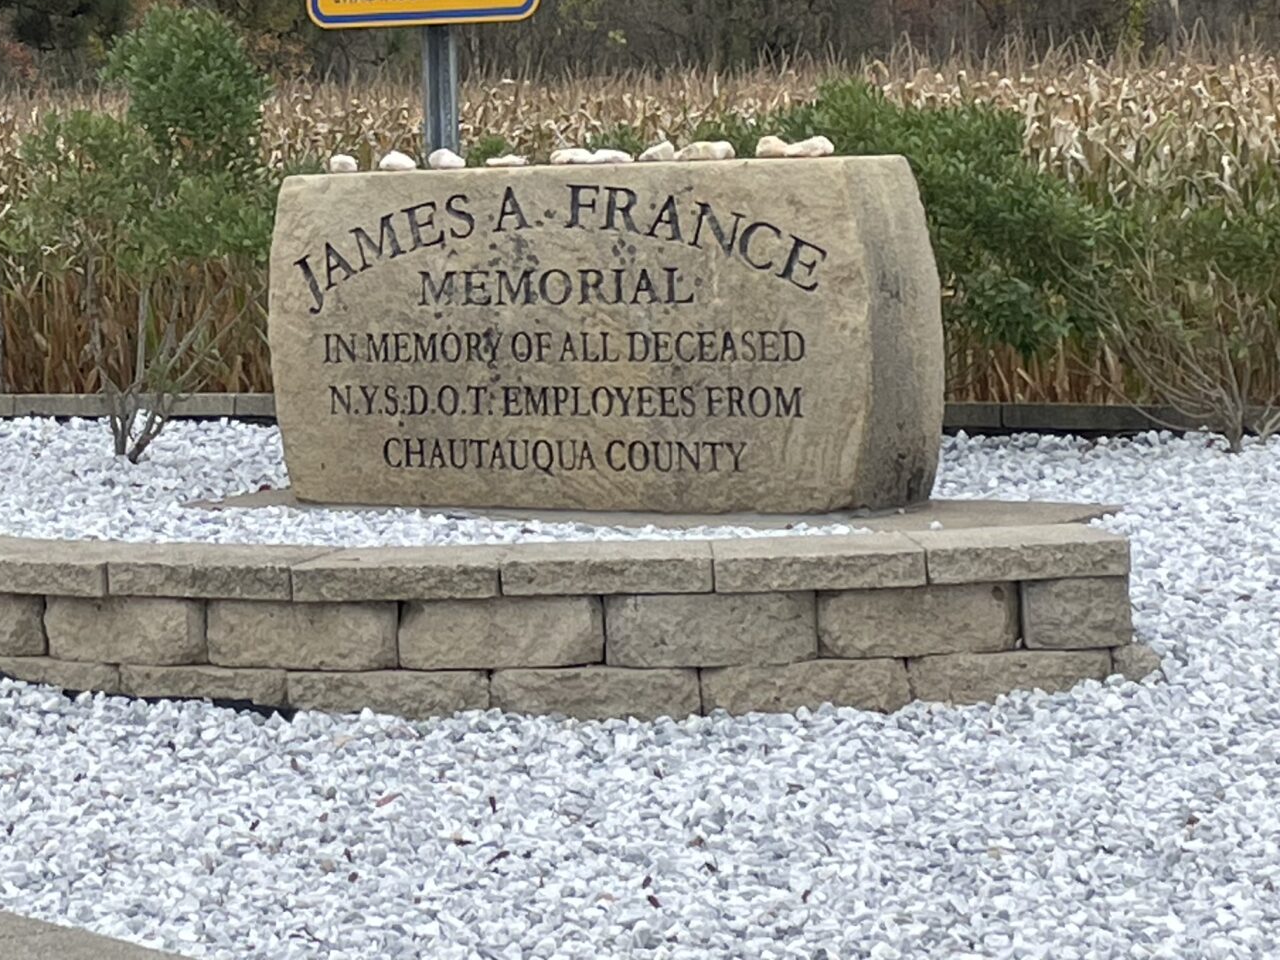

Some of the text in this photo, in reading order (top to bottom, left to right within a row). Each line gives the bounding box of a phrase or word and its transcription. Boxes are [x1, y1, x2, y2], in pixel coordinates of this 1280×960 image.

[293, 194, 476, 315] JAMES
[563, 183, 828, 292] FRANCE
[417, 267, 695, 307] MEMORIAL
[323, 330, 806, 364] IN MEMORY OF ALL DECEASED
[502, 385, 697, 418] EMPLOYEES
[706, 386, 805, 419] FROM
[383, 437, 748, 476] CHAUTAUQUA COUNTY
